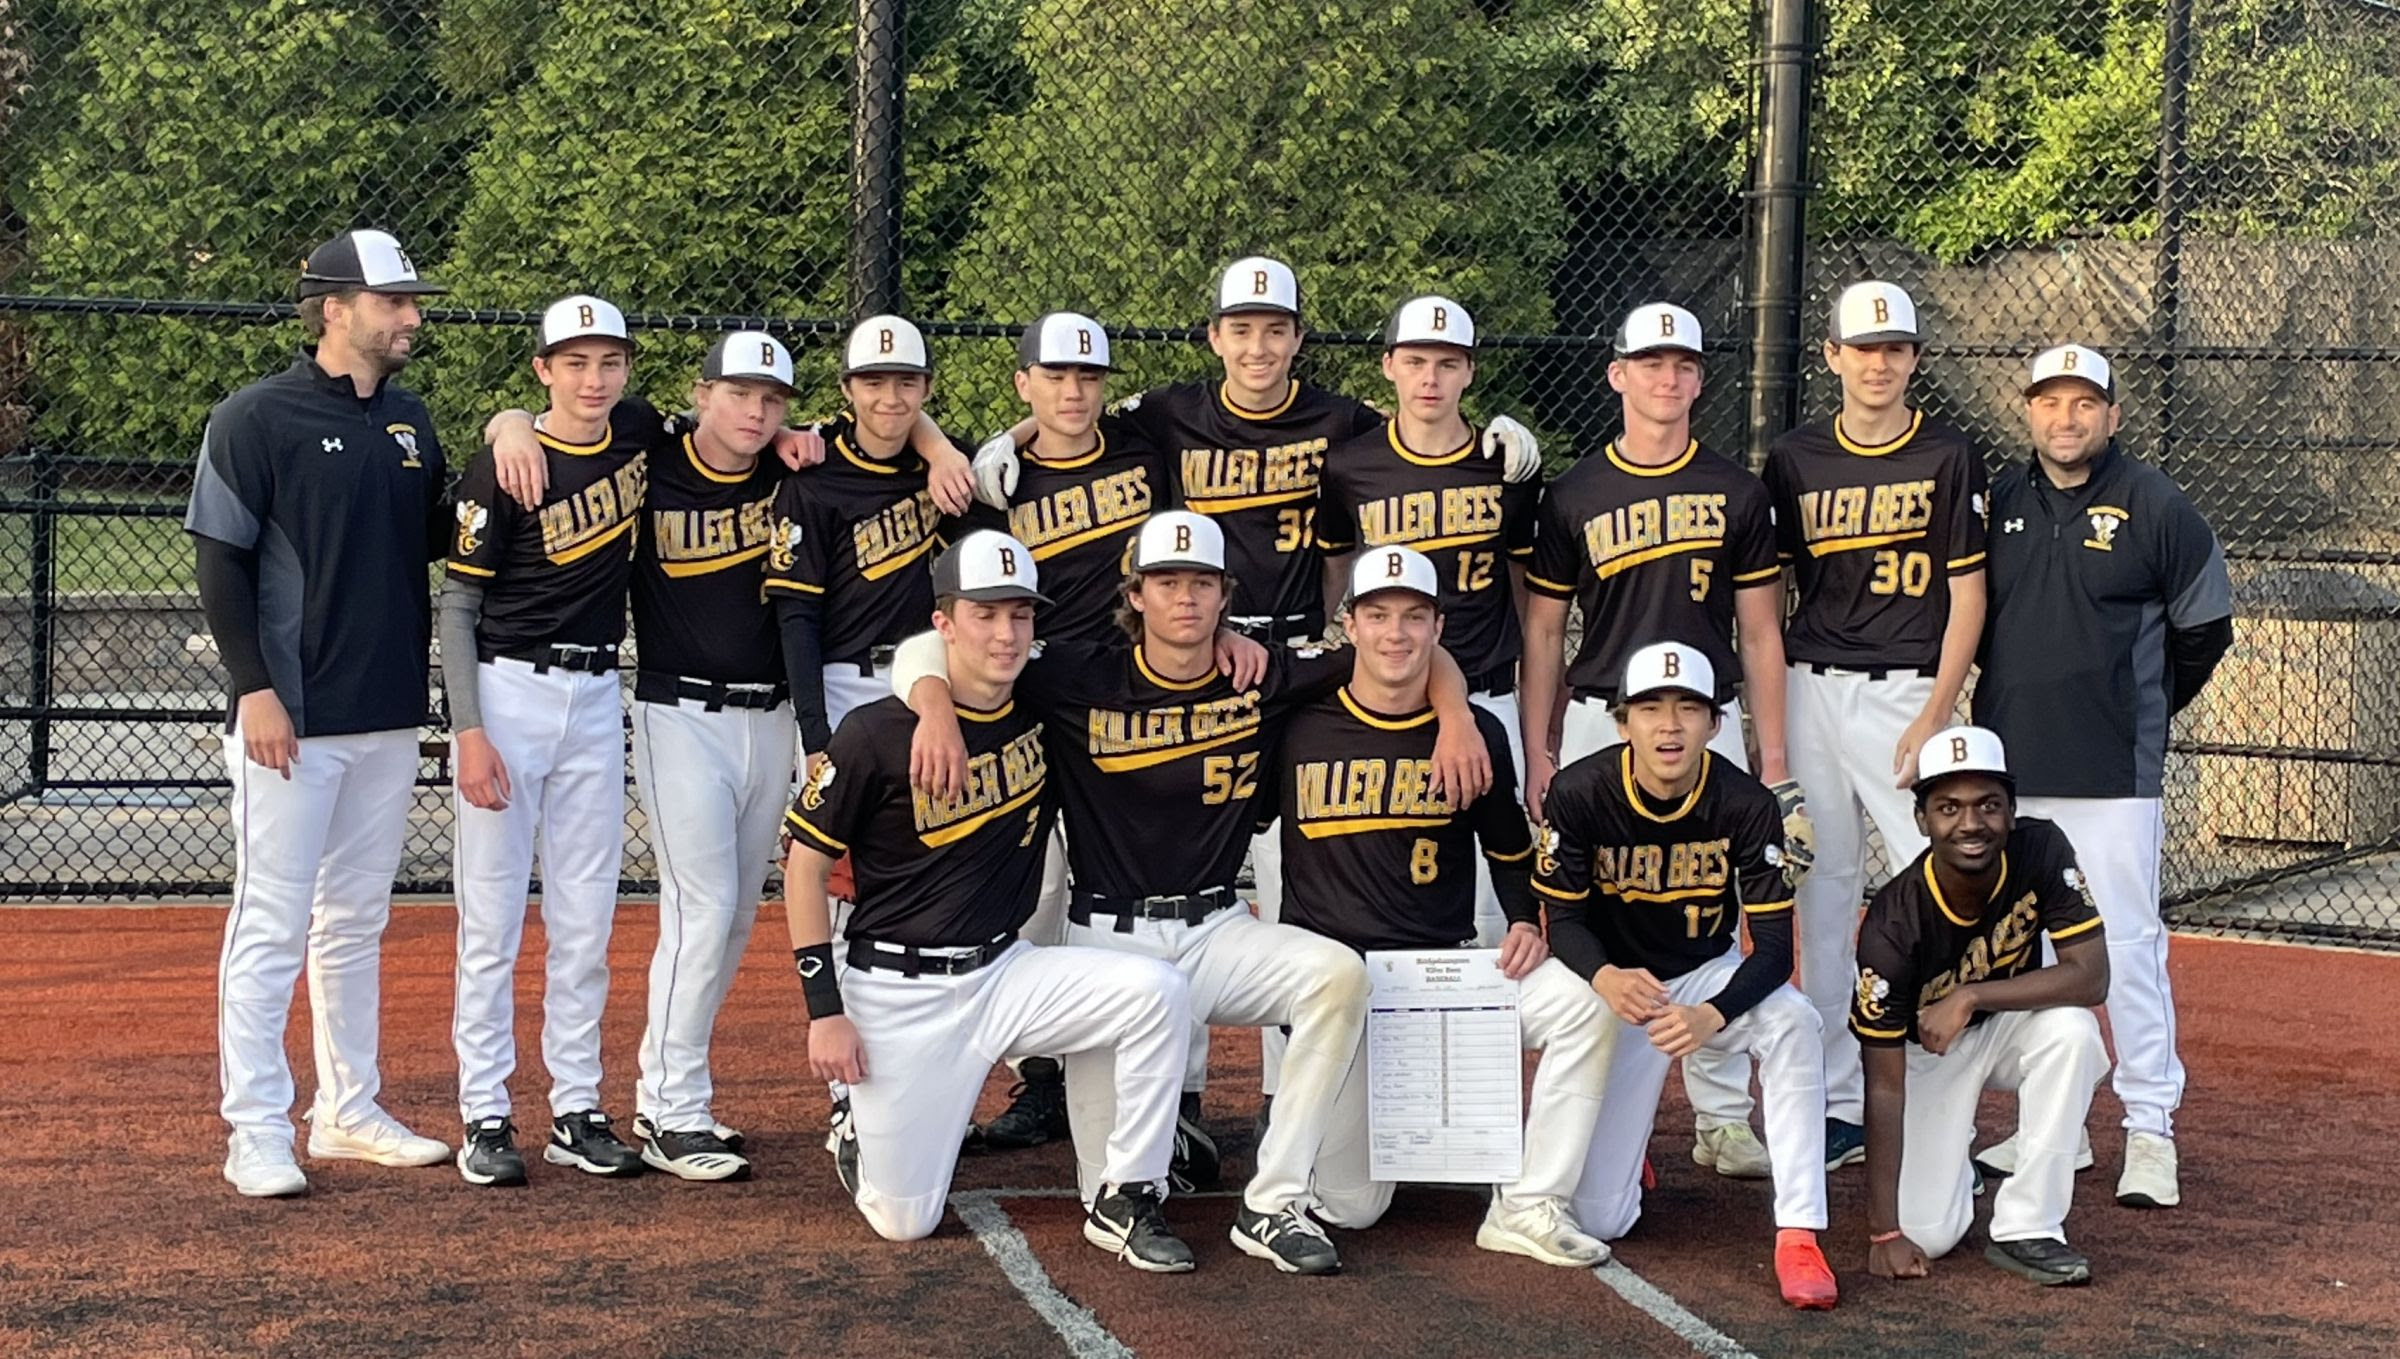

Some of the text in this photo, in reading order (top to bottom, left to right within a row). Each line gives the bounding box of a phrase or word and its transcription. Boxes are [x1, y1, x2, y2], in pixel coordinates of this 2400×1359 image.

[1253, 270, 1268, 295] B
[578, 304, 595, 328] B
[1432, 306, 1447, 331] B
[1660, 313, 1674, 337] B
[1873, 297, 1889, 323] B
[761, 342, 775, 366] B
[880, 329, 894, 354] B
[1077, 329, 1092, 355] B
[2062, 351, 2078, 370] B
[1181, 437, 1329, 498] KILLER BEES
[654, 507, 738, 560] KILLER
[739, 480, 781, 547] BEE
[1008, 485, 1092, 548] KILLER
[1092, 465, 1152, 525] BEES
[1358, 485, 1503, 547] KILLER BEES
[1868, 480, 1935, 533] BEES
[1174, 525, 1191, 552] B
[1584, 493, 1727, 567] KILLER BEES
[999, 547, 1016, 576] B
[1386, 552, 1403, 578] B
[1457, 551, 1495, 592] 12
[1870, 550, 1932, 598] 30
[1690, 558, 1714, 602] 5
[1663, 652, 1680, 678] B
[1089, 707, 1185, 755] KILLER
[1950, 737, 1968, 764] B
[1202, 751, 1261, 805] 52
[1296, 758, 1456, 819] KILLER BEE
[1410, 838, 1439, 885] 8
[1667, 838, 1730, 888] BEES
[1684, 903, 1724, 938] 17
